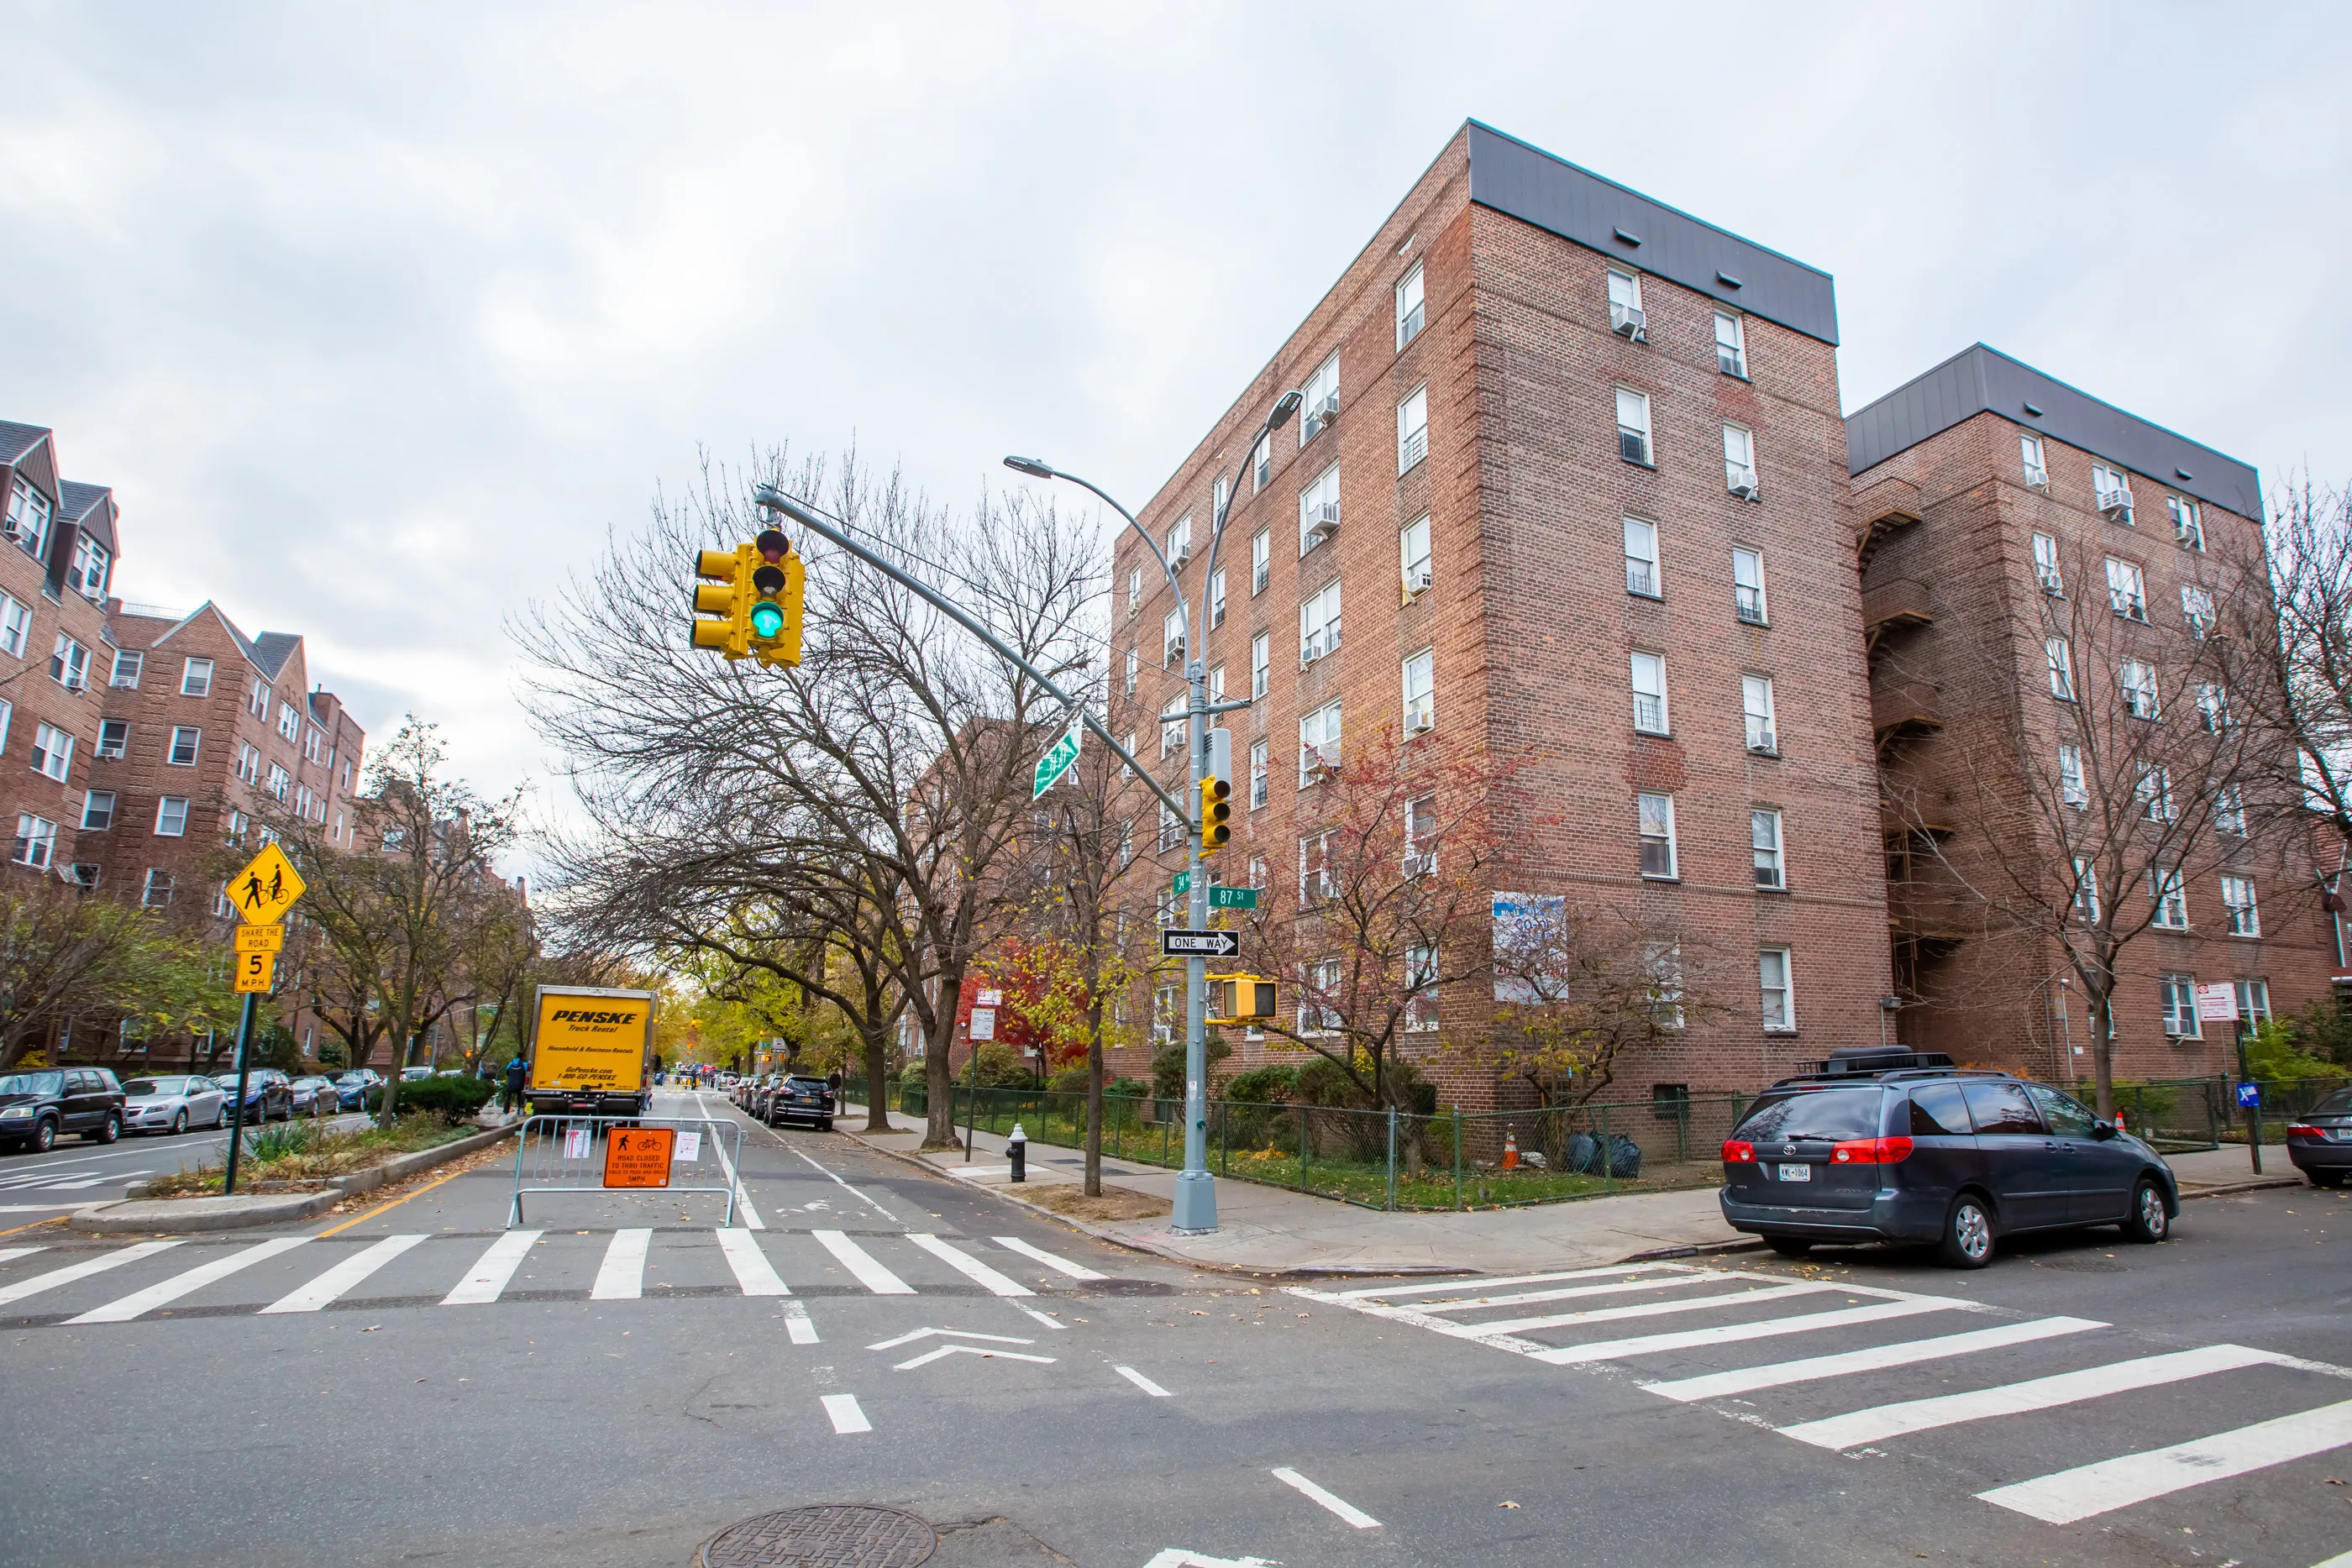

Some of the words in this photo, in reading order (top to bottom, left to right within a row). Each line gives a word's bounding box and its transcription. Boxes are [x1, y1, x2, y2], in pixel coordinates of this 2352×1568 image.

[1178, 875, 1184, 890] 34
[1220, 890, 1233, 904] 87
[1237, 891, 1244, 900] St
[241, 928, 264, 937] SHARE
[1175, 938, 1196, 948] ONE
[1207, 938, 1228, 949] WAY
[249, 955, 262, 975] 5
[551, 1010, 638, 1024] PENSKE
